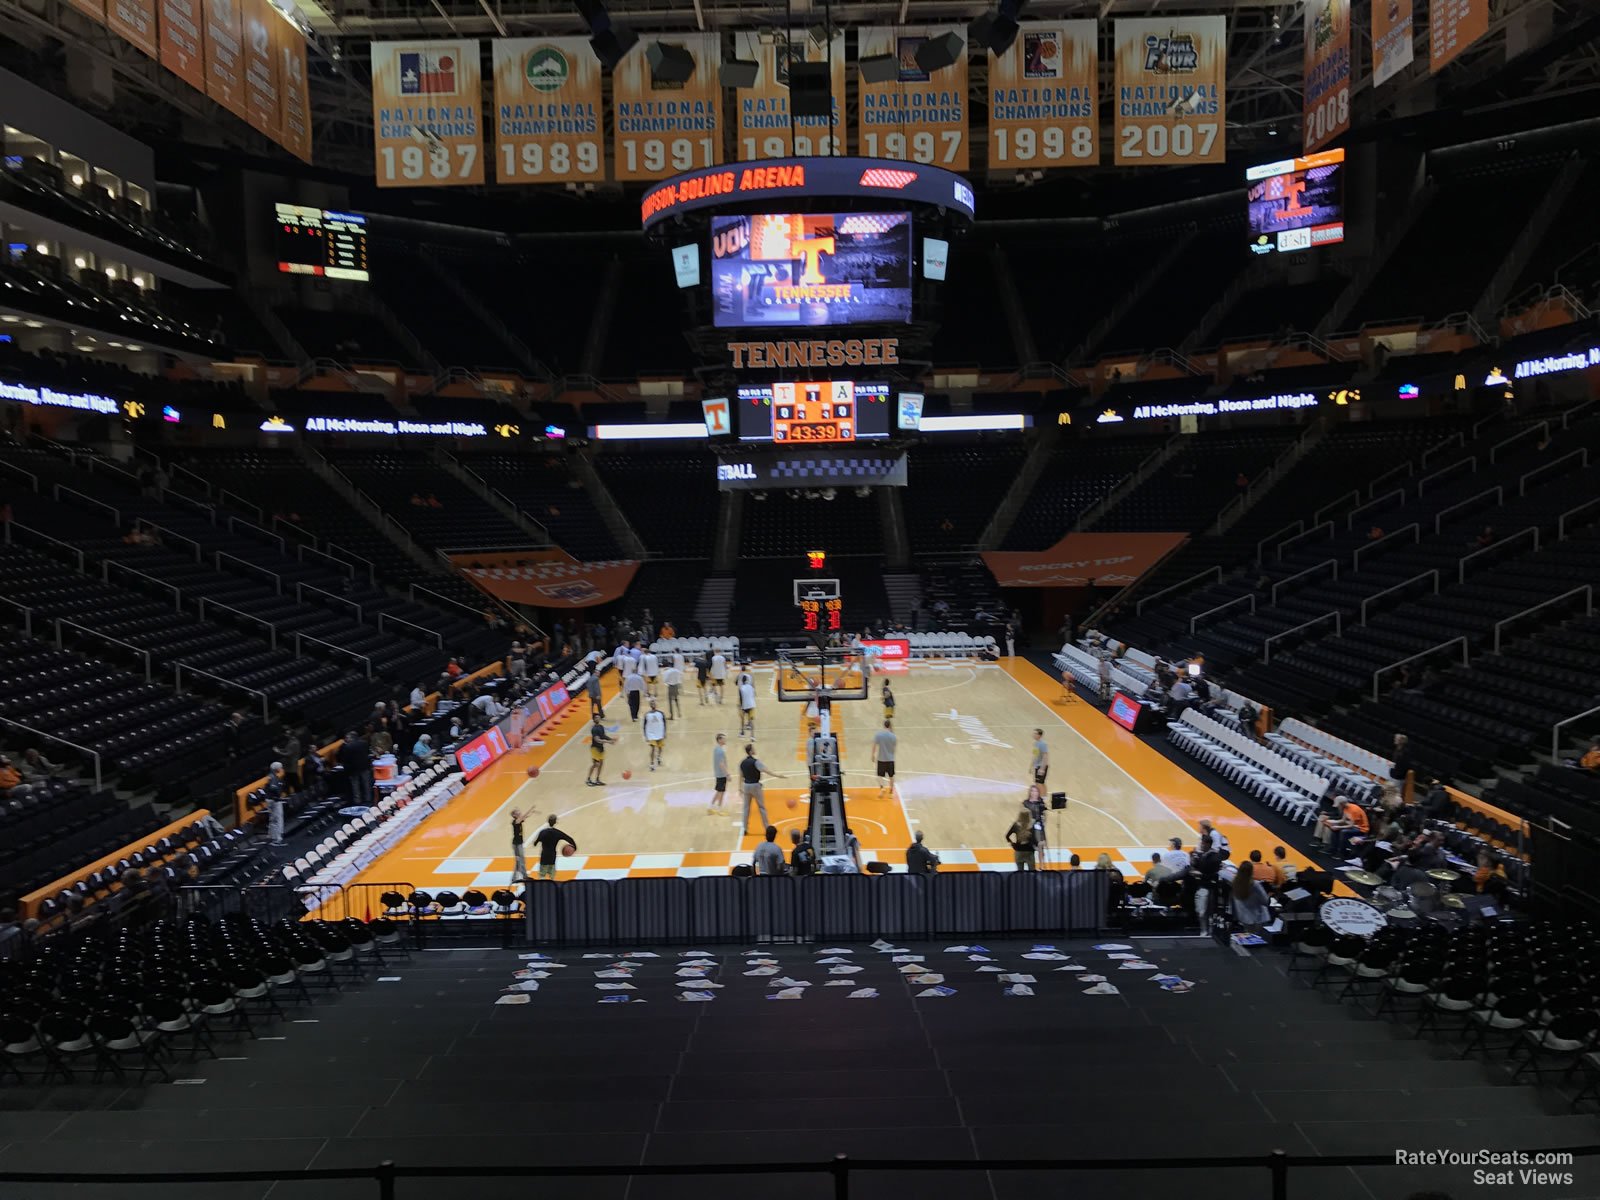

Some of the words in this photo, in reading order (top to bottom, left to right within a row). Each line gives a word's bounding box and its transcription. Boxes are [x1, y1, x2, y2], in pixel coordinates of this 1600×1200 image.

[865, 91, 961, 107] NATIONAL
[994, 87, 1091, 103] NATIONAL
[1120, 84, 1218, 100] NATIONAL
[501, 103, 597, 119] NATIONAL
[619, 100, 716, 116] NATIONAL
[742, 97, 840, 112] NATIL
[994, 102, 1092, 120] CHAMPIONS
[380, 106, 476, 122] NATIONAL
[864, 108, 962, 124] CHAMPIONS
[1305, 87, 1349, 149] 2008
[501, 118, 597, 135] CHAMPIONS
[619, 115, 716, 132] CHAMPIONS
[864, 131, 962, 164] 1997
[994, 125, 1093, 161] 1998
[1121, 123, 1218, 157] 2007
[382, 144, 477, 180] 1987
[501, 141, 598, 176] 1989
[622, 138, 714, 172] 1991
[739, 164, 804, 191] ARENA
[792, 237, 835, 284] T
[774, 285, 851, 298] TENNESSEE
[727, 338, 899, 369] TENNESSEE
[1133, 405, 1150, 419] All
[1151, 401, 1218, 417] McMorning,
[1219, 400, 1251, 412] Noon
[1252, 396, 1276, 409] and
[1277, 393, 1318, 408] Night.
[306, 417, 325, 431] All
[326, 418, 398, 434] McMorning,
[398, 420, 430, 433] Noon
[430, 422, 452, 434] and
[705, 403, 726, 431] T
[791, 425, 836, 440] 43:39
[1019, 560, 1090, 572] ROCKY
[1094, 555, 1135, 567] TOP
